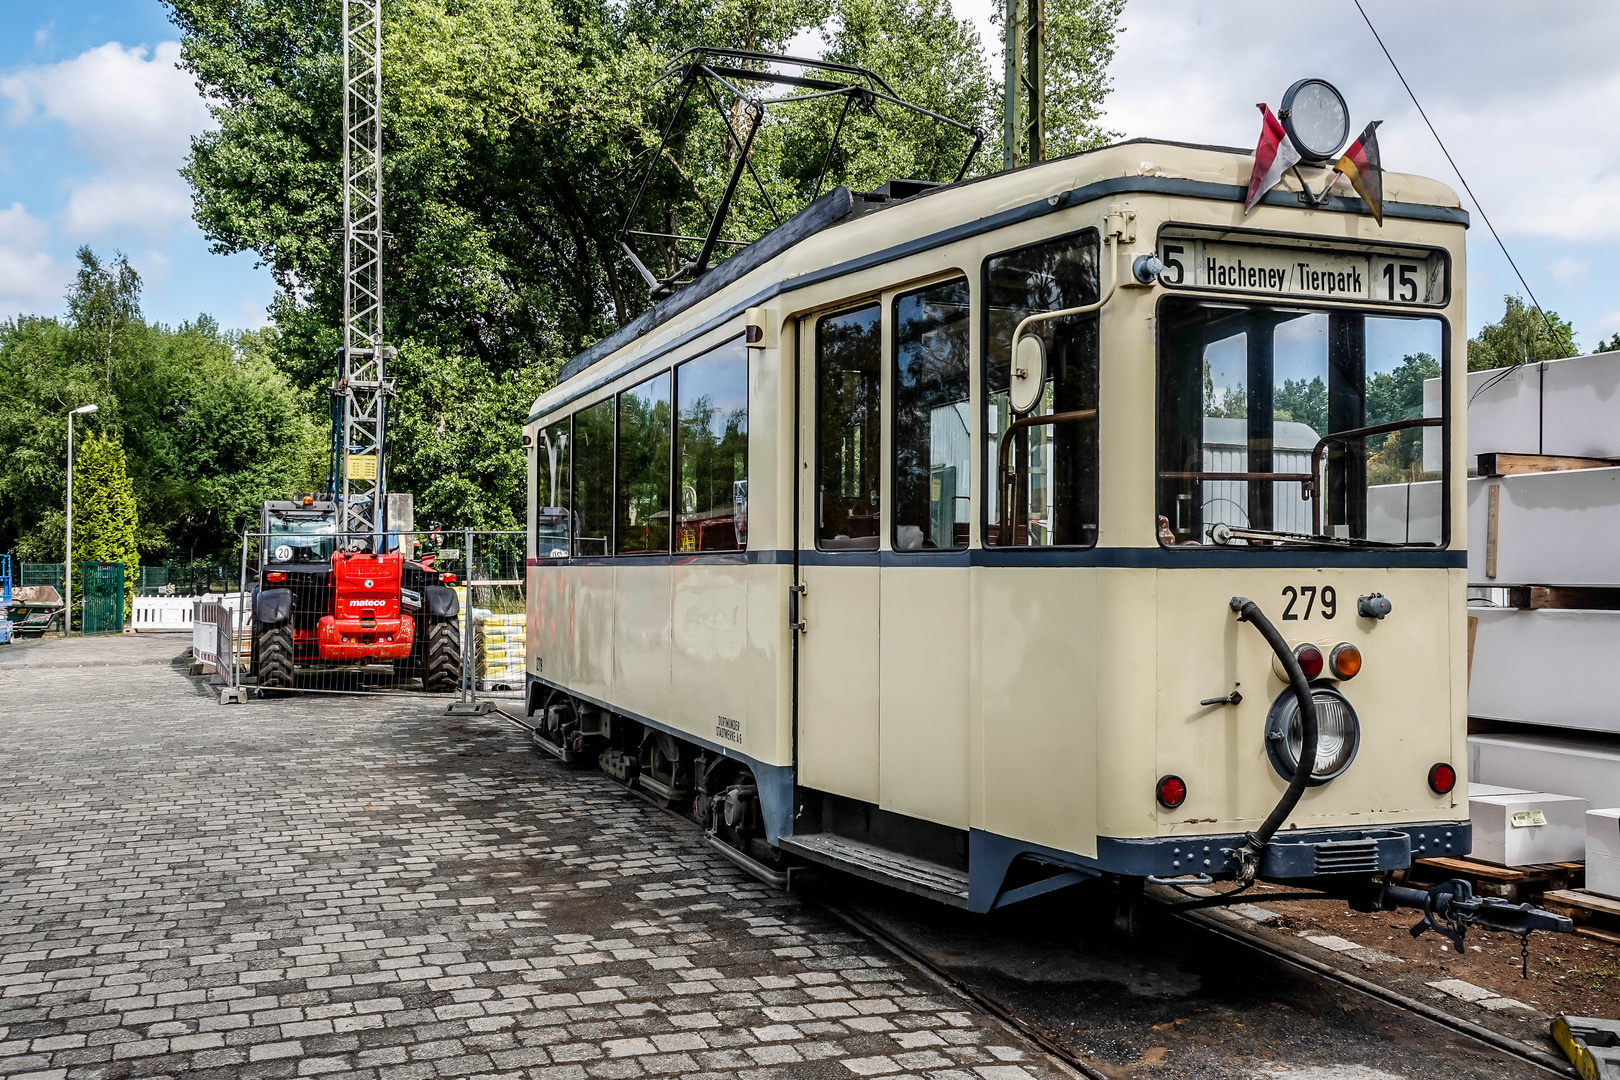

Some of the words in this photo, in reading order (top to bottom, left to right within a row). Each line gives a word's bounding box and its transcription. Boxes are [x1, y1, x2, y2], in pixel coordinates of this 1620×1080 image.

[1383, 263, 1417, 302] 15
[278, 547, 290, 559] 20
[349, 599, 386, 607] mateco
[1281, 585, 1337, 621] 279
[718, 715, 740, 731] DORTMUNDER
